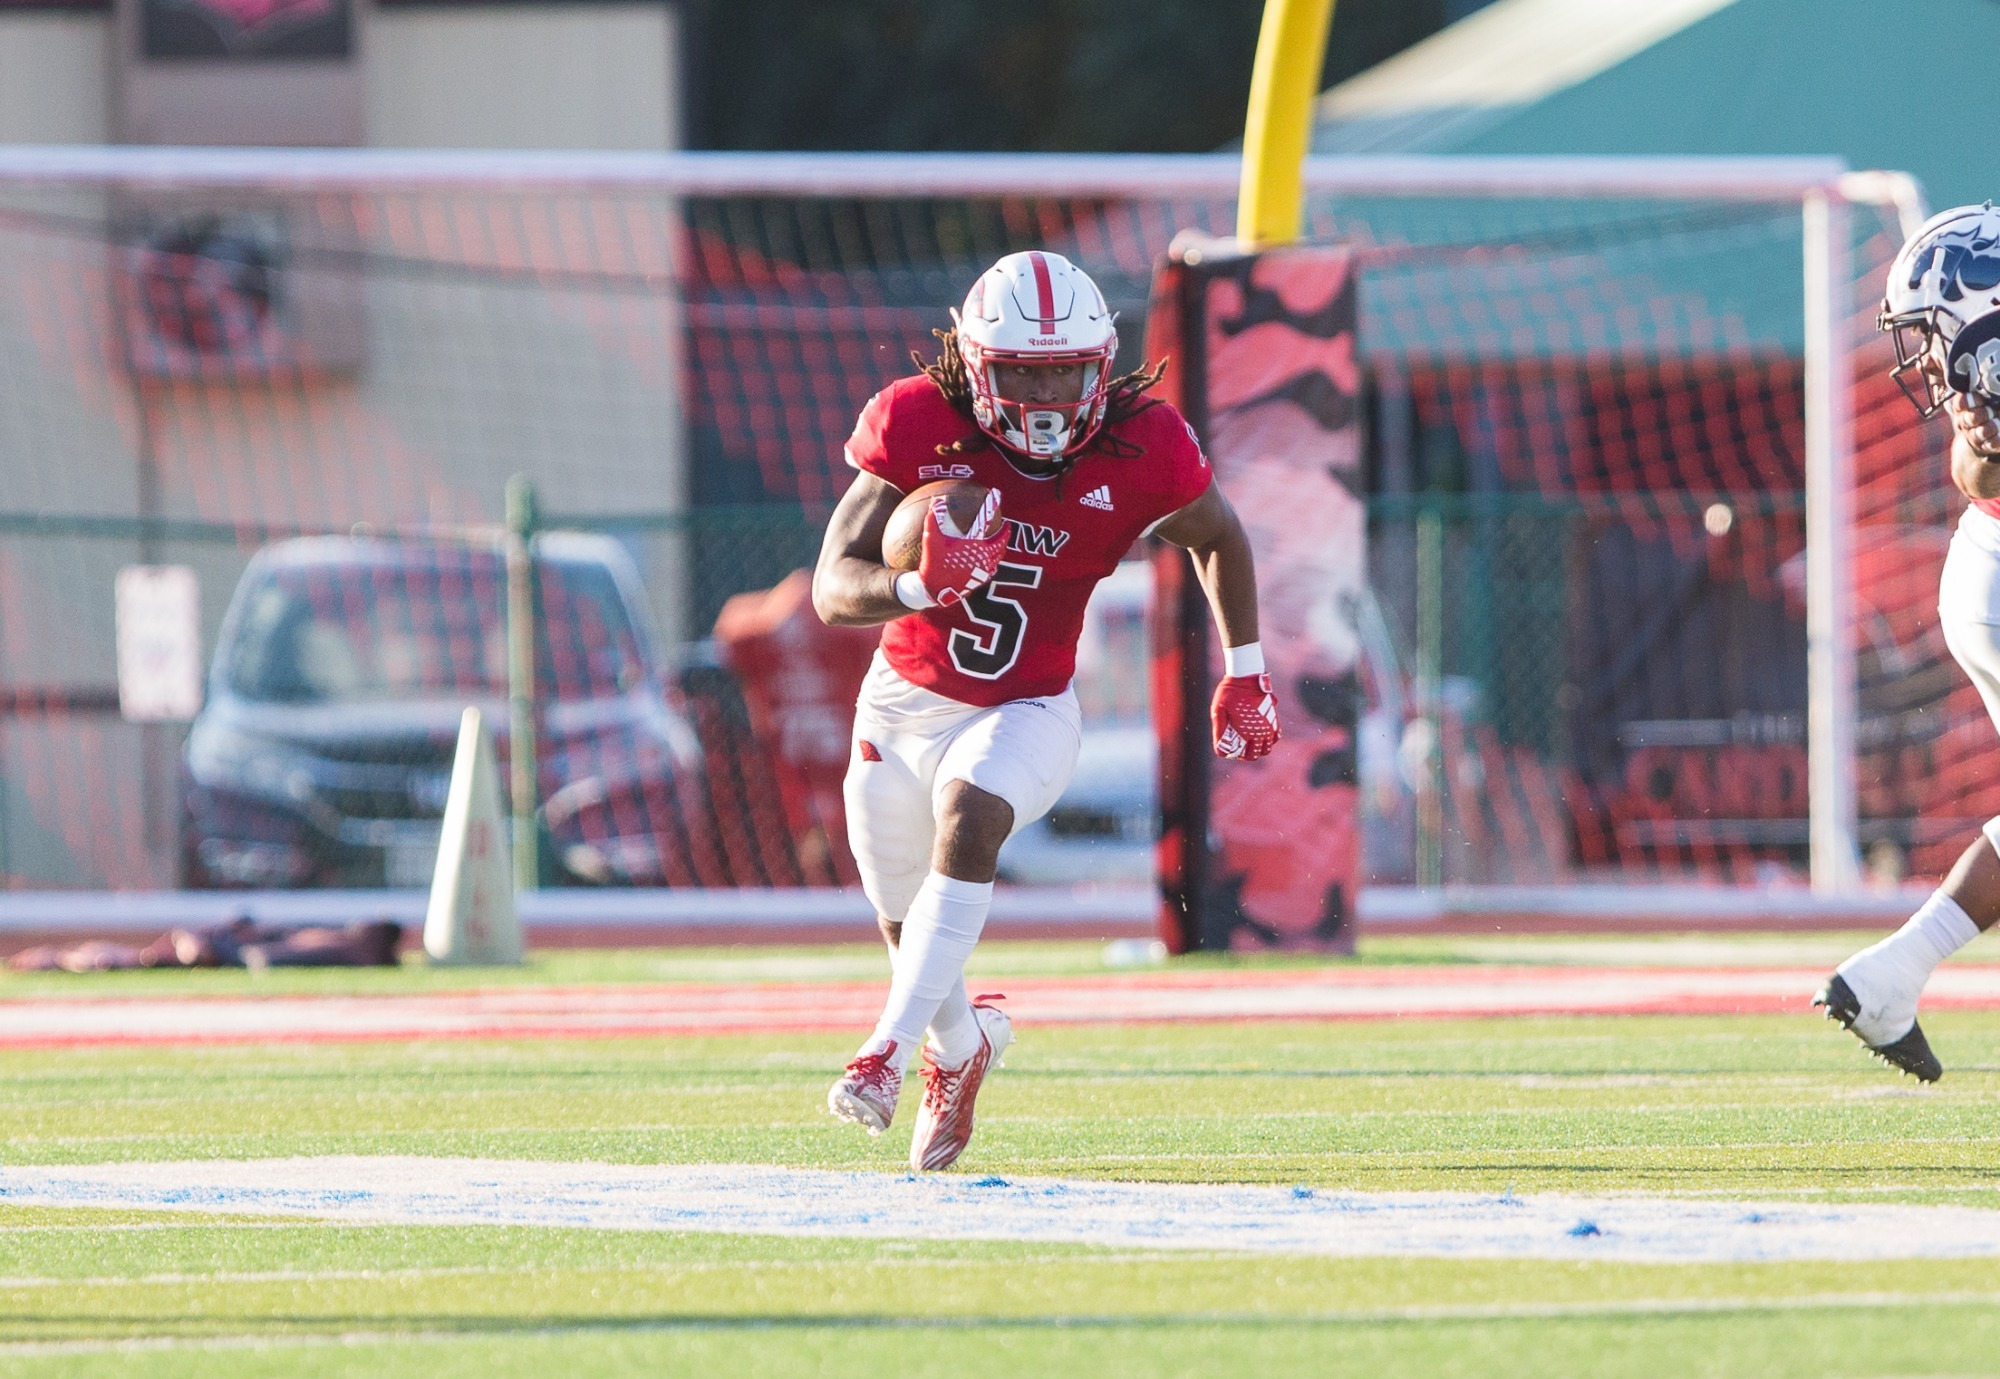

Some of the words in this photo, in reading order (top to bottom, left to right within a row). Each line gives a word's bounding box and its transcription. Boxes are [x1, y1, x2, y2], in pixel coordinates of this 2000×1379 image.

[1028, 337, 1068, 346] Riddell
[1079, 496, 1114, 511] adidas
[947, 560, 1044, 681] 5
